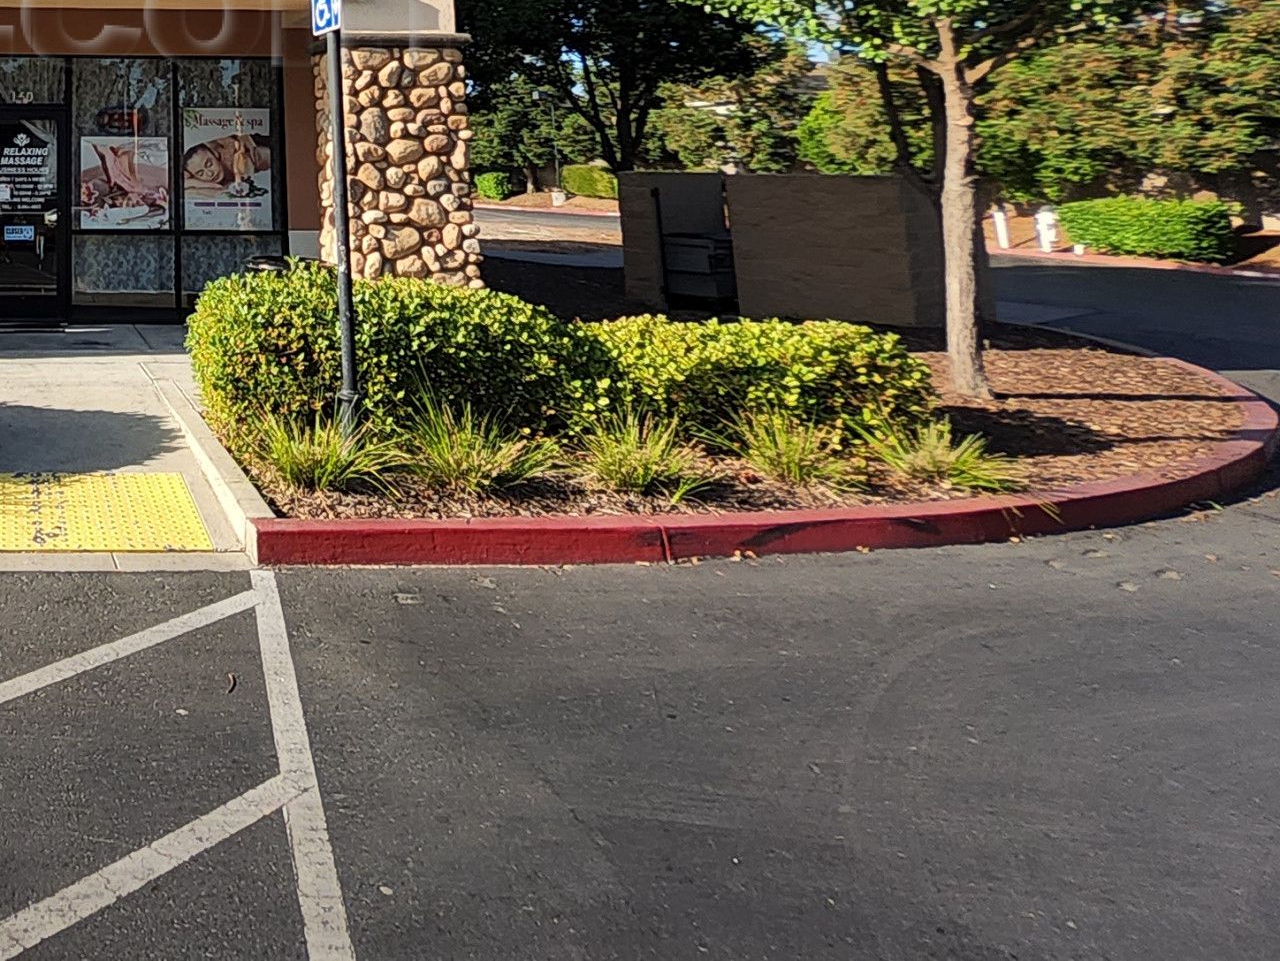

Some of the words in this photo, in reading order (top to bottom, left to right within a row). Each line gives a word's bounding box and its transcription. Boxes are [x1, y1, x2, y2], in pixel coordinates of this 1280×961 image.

[195, 114, 232, 129] Massage
[247, 118, 264, 129] spa
[3, 147, 49, 156] RELAXING
[0, 157, 43, 165] MASSAGE
